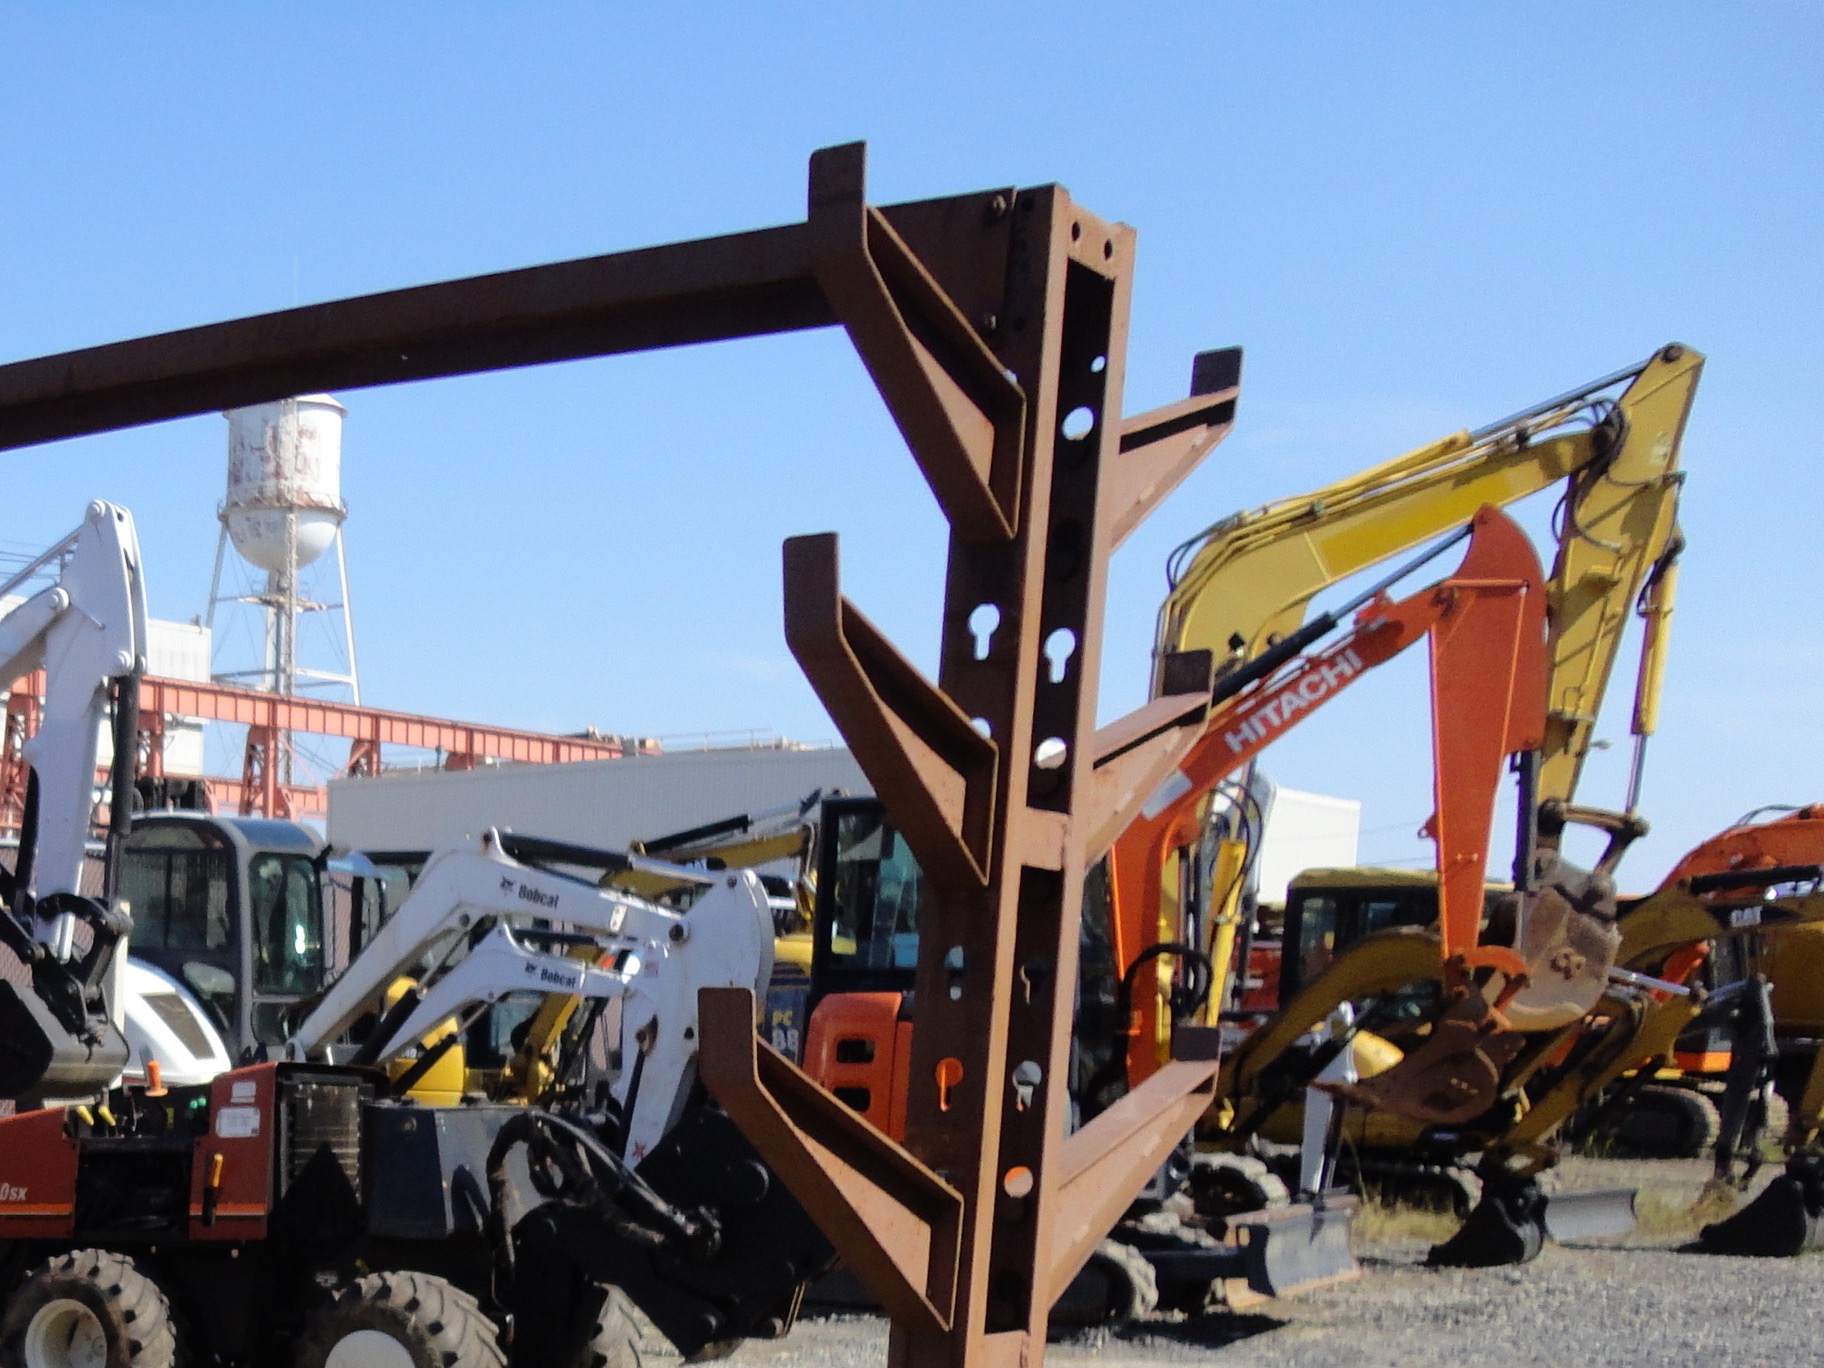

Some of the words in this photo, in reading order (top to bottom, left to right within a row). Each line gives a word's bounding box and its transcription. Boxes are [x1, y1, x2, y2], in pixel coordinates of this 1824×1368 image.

[1224, 648, 1363, 753] HITACHI
[519, 884, 560, 909] Bobcat
[540, 968, 576, 989] Bobcat
